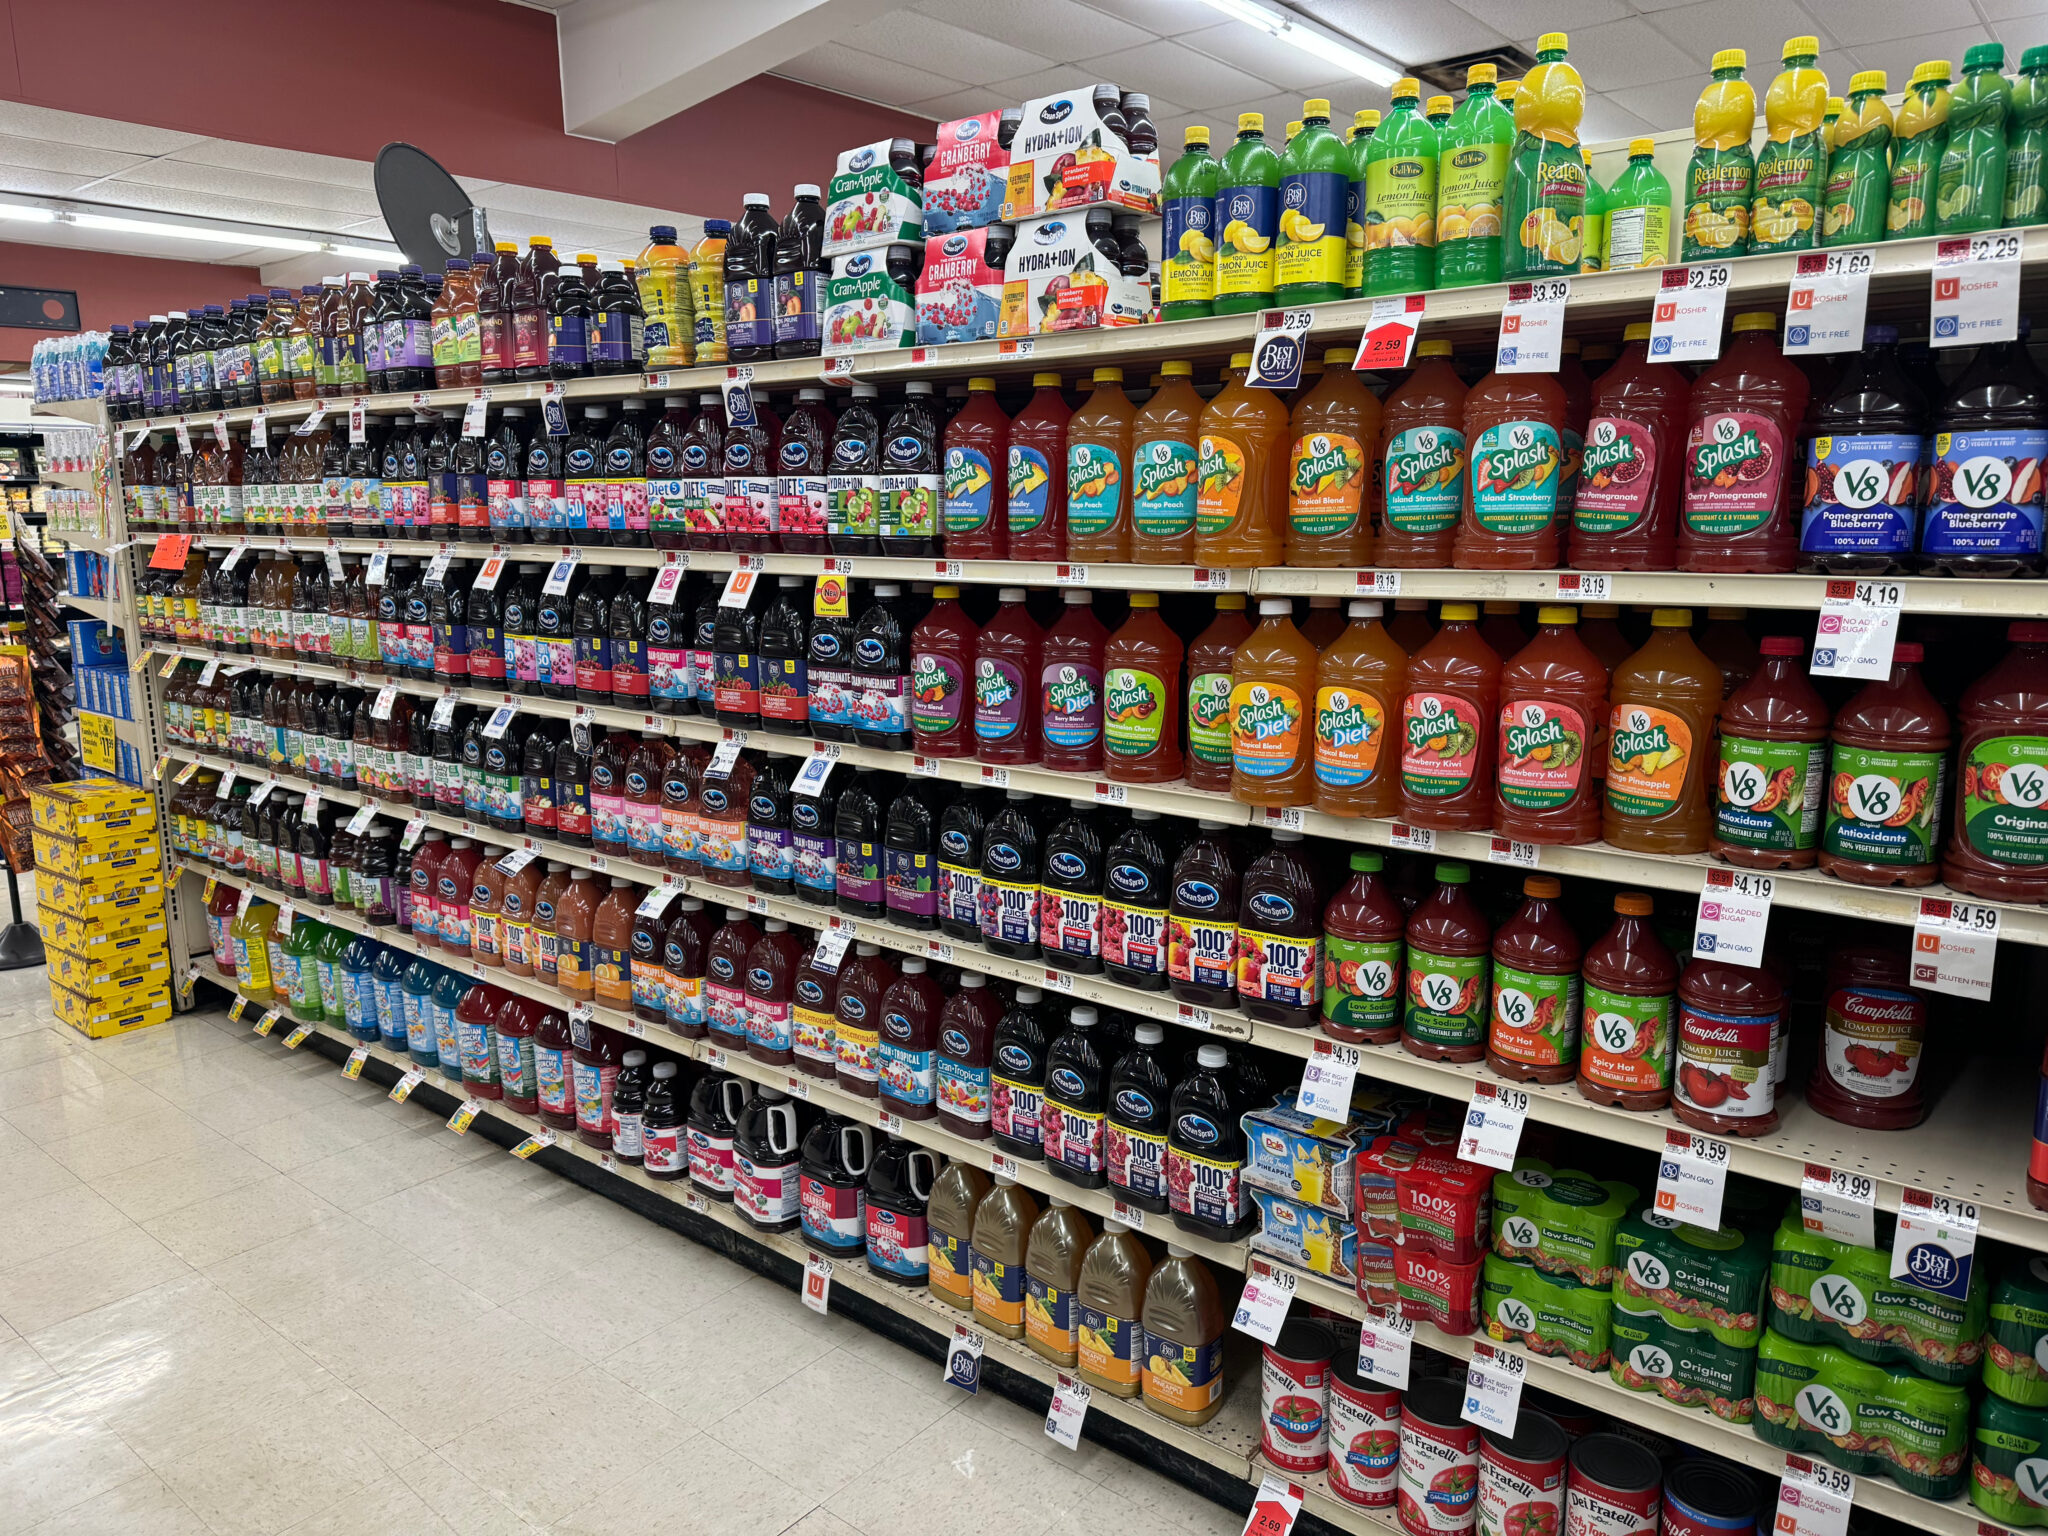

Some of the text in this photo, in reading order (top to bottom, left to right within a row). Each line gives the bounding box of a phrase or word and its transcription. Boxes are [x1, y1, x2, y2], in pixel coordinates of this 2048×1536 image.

[1459, 172, 1478, 181] 100%
[1694, 166, 1751, 184] ReaLemon
[1757, 158, 1814, 178] ReaLemon
[1441, 180, 1498, 195] Lemon Juice
[1972, 237, 2018, 260] $2.29
[929, 258, 977, 280] CRANBERRY
[1244, 261, 1268, 270] JUICE
[1828, 255, 1870, 276] $1.69
[1689, 270, 1728, 289] $2.59
[1960, 281, 1998, 291] KOSHER
[1533, 283, 1567, 302] $3.39
[1814, 294, 1848, 303] KOSHER
[1676, 306, 1707, 314] KOSHER
[1284, 314, 1311, 330] $2.59
[1959, 319, 2002, 330] DYE FREE
[1688, 339, 1707, 347] FREE
[1810, 330, 1850, 339] DYE FREE
[1374, 340, 1401, 351] 2.59
[1260, 345, 1293, 370] BEST YET
[1517, 352, 1530, 360] DYE
[1513, 429, 1531, 446] V8
[1717, 423, 1735, 440] V8
[1155, 447, 1169, 462] V8
[1491, 444, 1547, 479] Splash
[1697, 435, 1758, 470] Splash
[1141, 457, 1186, 486] Splash
[1843, 467, 1880, 501] V8
[1142, 500, 1184, 509] Mango Peach
[1481, 493, 1552, 503] Island Strawberry
[1687, 492, 1768, 502] Cherry Pomegranate
[569, 498, 583, 517] 50
[1822, 511, 1894, 522] Pomegranate
[1830, 520, 1885, 530] Blueberry
[1834, 538, 1879, 546] 100% JUICE
[1856, 585, 1899, 606] $4.19
[915, 671, 946, 690] Splash
[1050, 680, 1089, 704] Splash
[1109, 687, 1147, 711] Splash
[1065, 691, 1096, 713] Diet
[1239, 699, 1284, 730] Splash
[1526, 707, 1542, 724] V8
[1256, 716, 1291, 740] Diet
[1264, 742, 1282, 751] Blend
[1508, 724, 1563, 754] Splash
[1613, 730, 1667, 759] Splash
[1504, 765, 1567, 779] Strawberry Kiwi
[1628, 776, 1671, 790] Pineapple
[1729, 768, 1758, 800] V8
[1856, 781, 1891, 817] V8
[1718, 811, 1773, 829] Antioxidants
[1411, 827, 1431, 845] $3.19
[1838, 825, 1907, 844] Antioxidants
[1512, 841, 1534, 860] $3.19
[1840, 839, 1855, 849] 100%
[1857, 842, 1886, 853] VEGETABLE
[1887, 845, 1901, 855] JUICE
[1734, 874, 1771, 898] $4.19
[1720, 914, 1745, 923] SUGAR
[1721, 905, 1762, 918] NO ADDED
[1951, 904, 1997, 930] $4.59
[1266, 943, 1308, 968] 100%
[1716, 942, 1753, 953] NON GMO
[1940, 943, 1975, 955] KOSHER
[1267, 965, 1301, 977] JUICE
[1937, 972, 1991, 989] GLUTEN FREE
[1426, 981, 1452, 1006] V8
[1843, 995, 1914, 1022] Campbell's
[1415, 1013, 1465, 1029] Low Sodium
[1683, 1017, 1740, 1043] Campbell's
[1842, 1018, 1911, 1035] TOMATO JUICE
[1599, 1018, 1625, 1048] V8
[1333, 1043, 1359, 1066] $4.19
[1681, 1041, 1741, 1058] TOMATO JUICE
[1592, 1056, 1634, 1073] Spicy Hot
[1066, 1113, 1096, 1139] 100%
[1064, 1135, 1090, 1147] JUICE
[1691, 1134, 1727, 1162] $3.59
[1257, 1162, 1292, 1179] PINEAPPLE
[1831, 1170, 1871, 1197] $3.99
[1410, 1189, 1457, 1218] 100%
[1911, 1249, 1953, 1274] BEST
[1635, 1257, 1661, 1286] V8
[1675, 1269, 1730, 1295] Original
[1820, 1281, 1856, 1320] V8
[1874, 1293, 1964, 1323] Low Sodium
[1875, 1308, 1960, 1337] 100% VEGETABLE JUICE
[1494, 1348, 1524, 1372] $4.89
[1401, 1429, 1460, 1464] Dei Fratelli
[1813, 1463, 1850, 1492] $5.59
[1451, 1491, 1472, 1503] 100
[1258, 1514, 1282, 1533] 2.69
